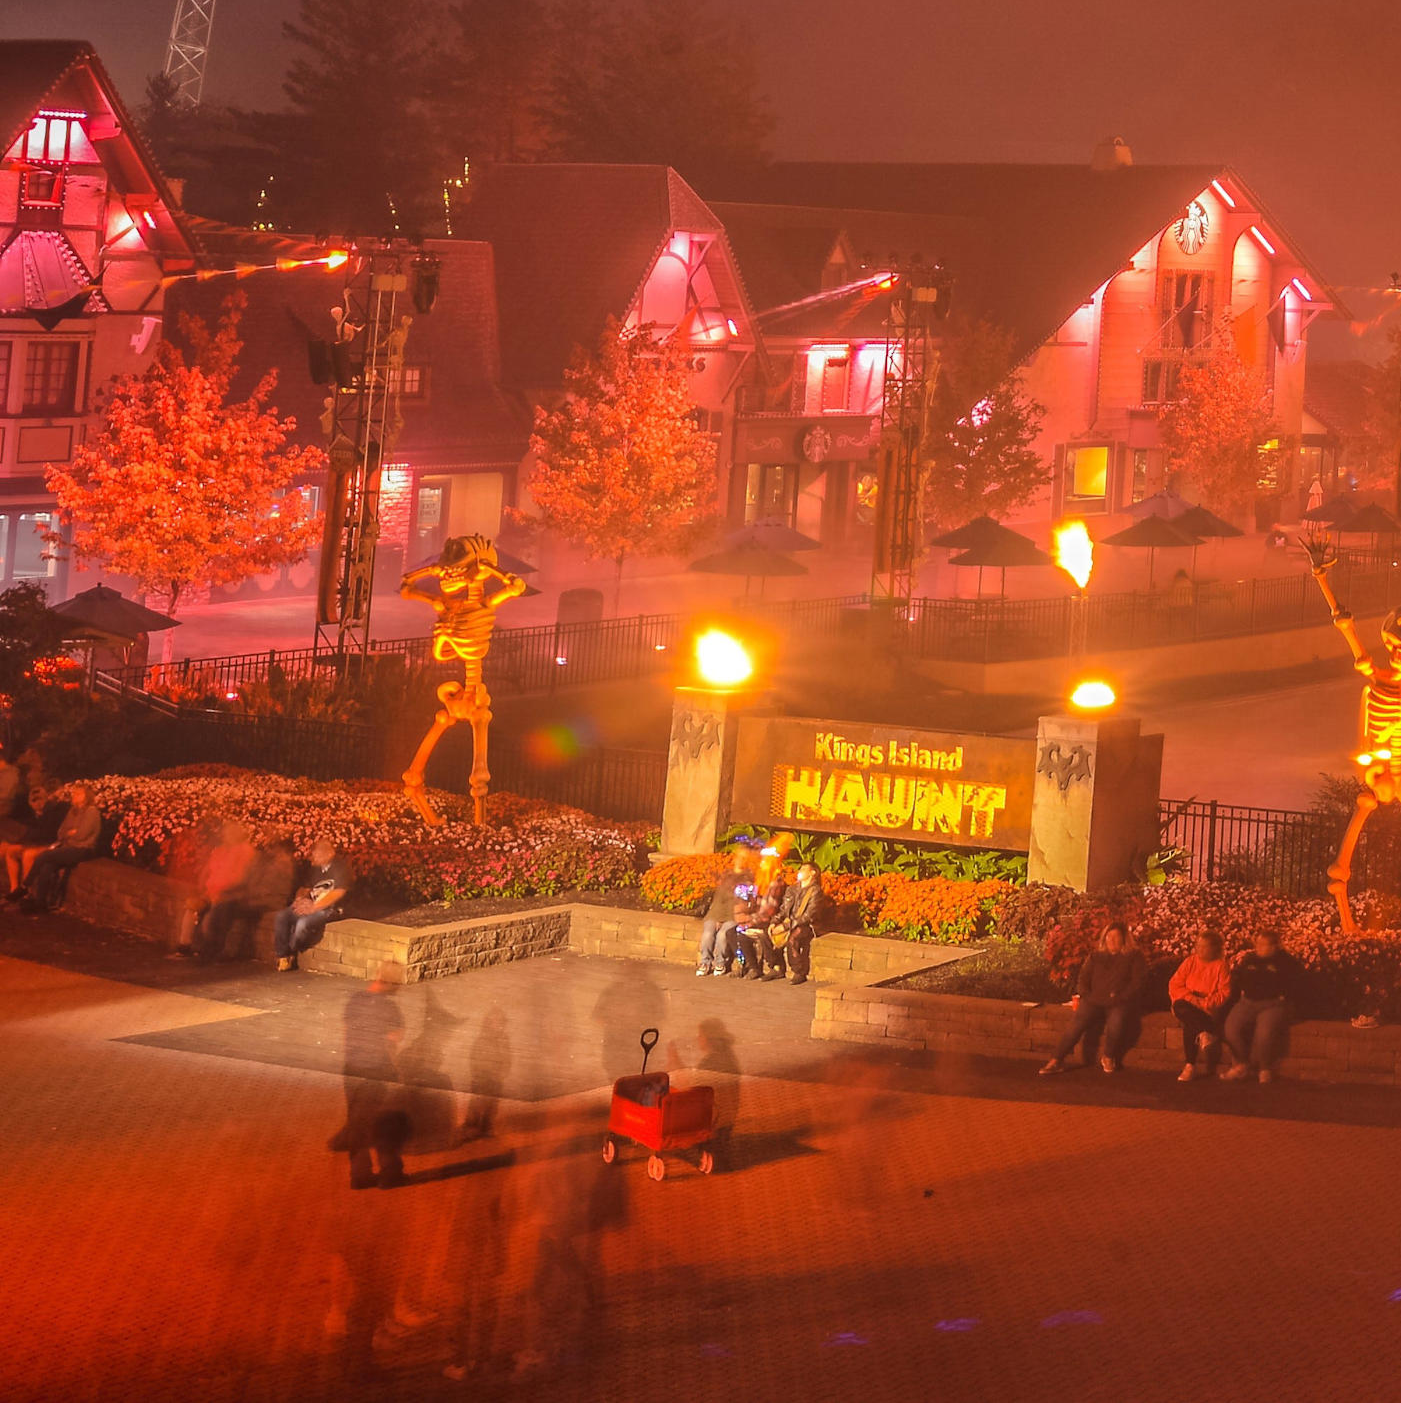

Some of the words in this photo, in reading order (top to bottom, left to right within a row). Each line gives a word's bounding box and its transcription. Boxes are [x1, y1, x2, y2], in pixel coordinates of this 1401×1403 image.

[815, 732, 884, 769] Kings
[888, 740, 963, 771] Island
[772, 765, 1006, 838] HAUNT
